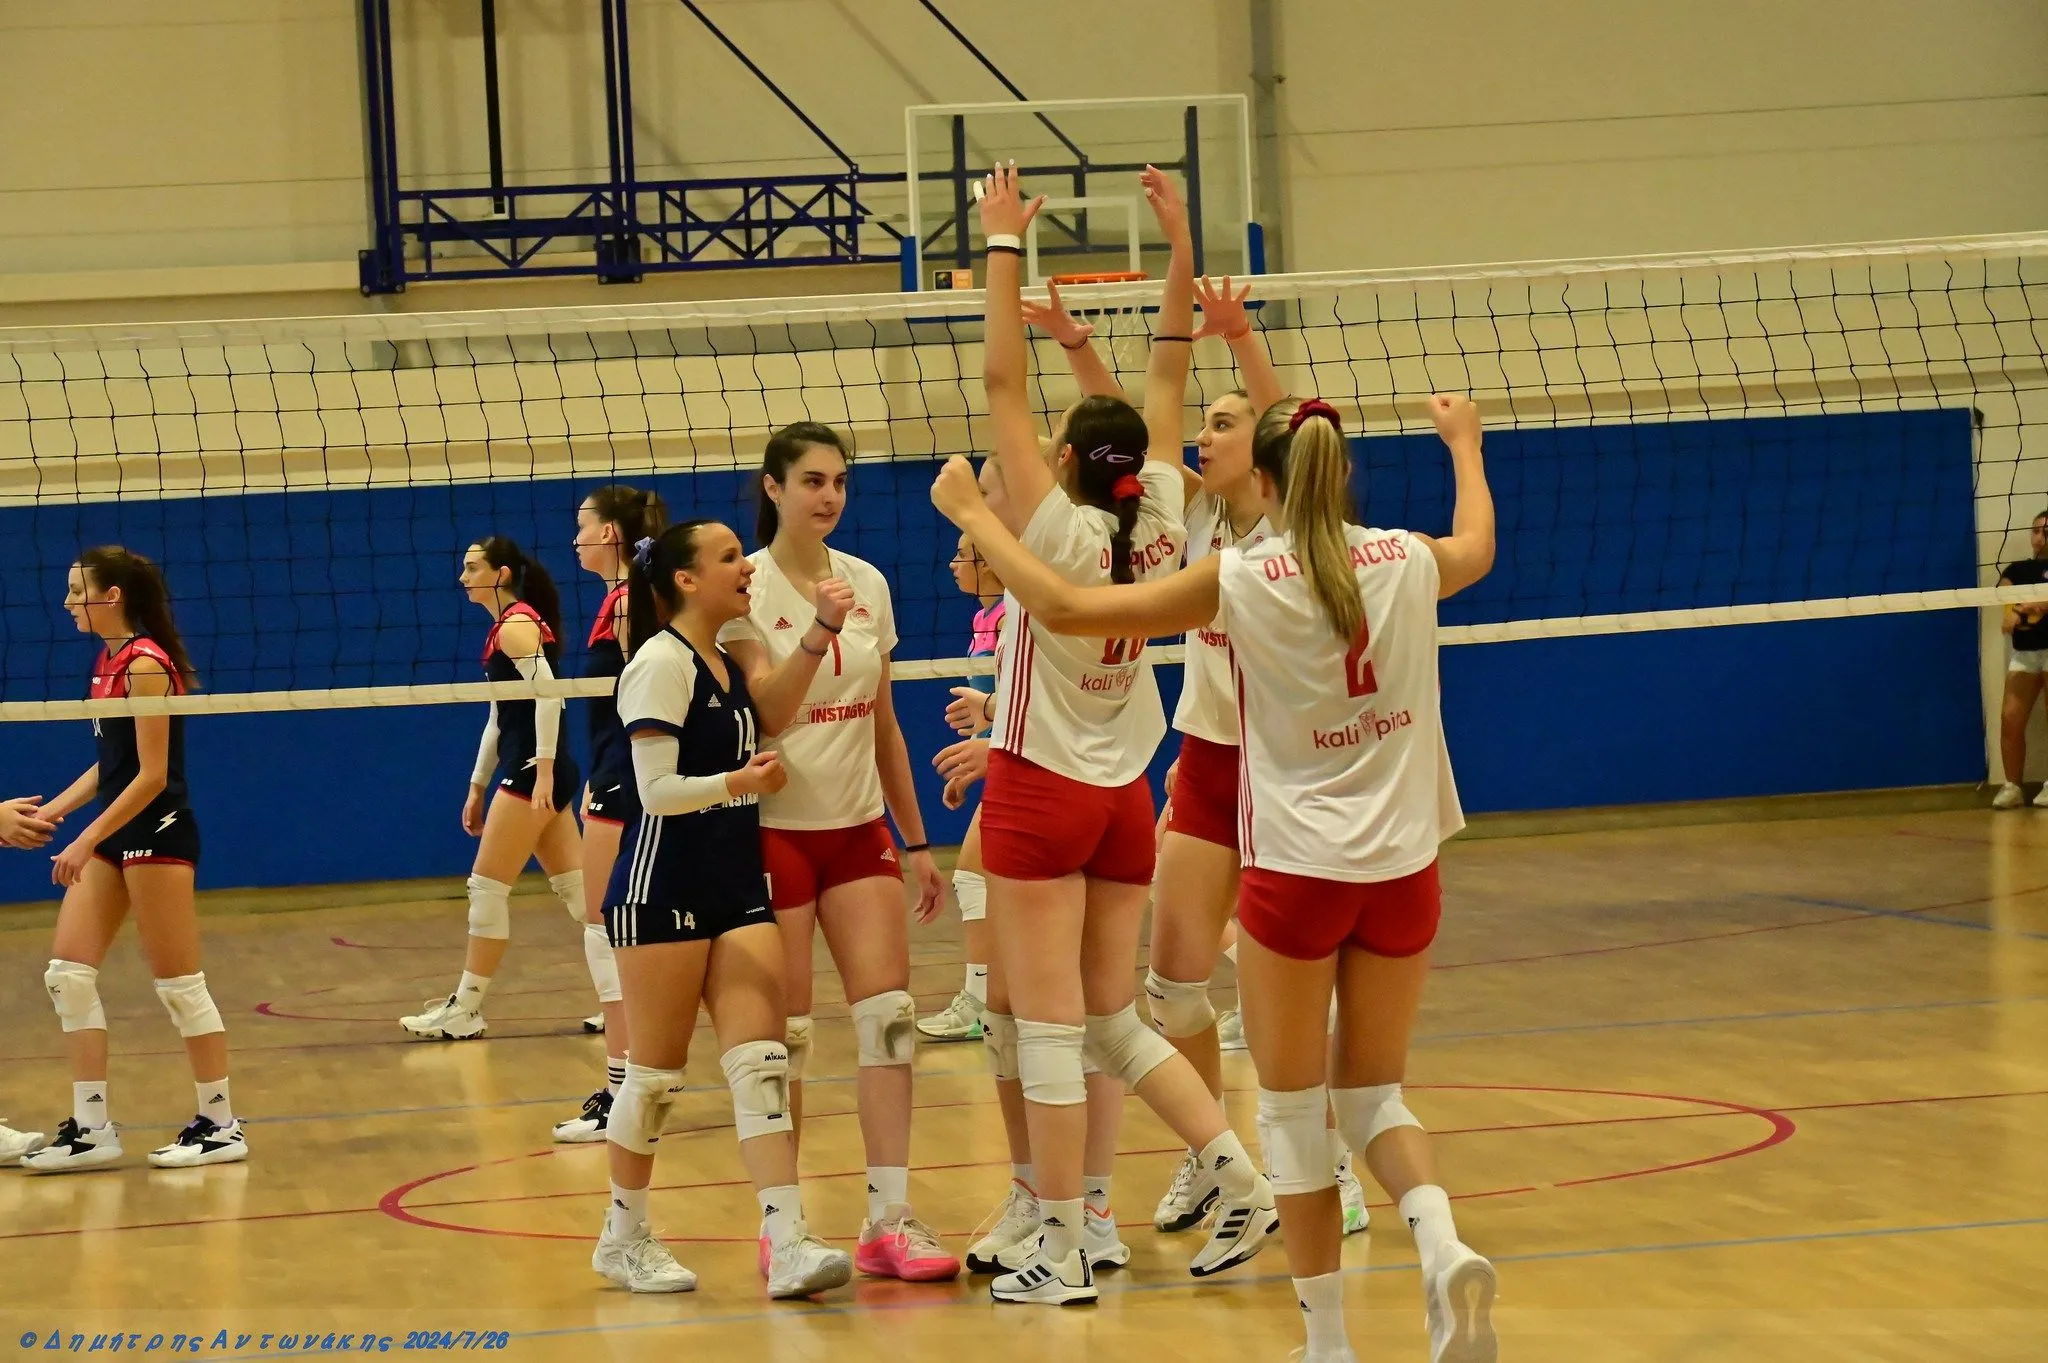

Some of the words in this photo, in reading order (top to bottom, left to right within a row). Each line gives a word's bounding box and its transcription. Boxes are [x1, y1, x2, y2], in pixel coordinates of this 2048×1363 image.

[1263, 537, 1407, 582] OLYACOS
[1344, 613, 1378, 698] 2
[1080, 673, 1114, 691] kali
[733, 707, 757, 760] 14
[1313, 723, 1360, 749] kali
[671, 909, 696, 930] 14
